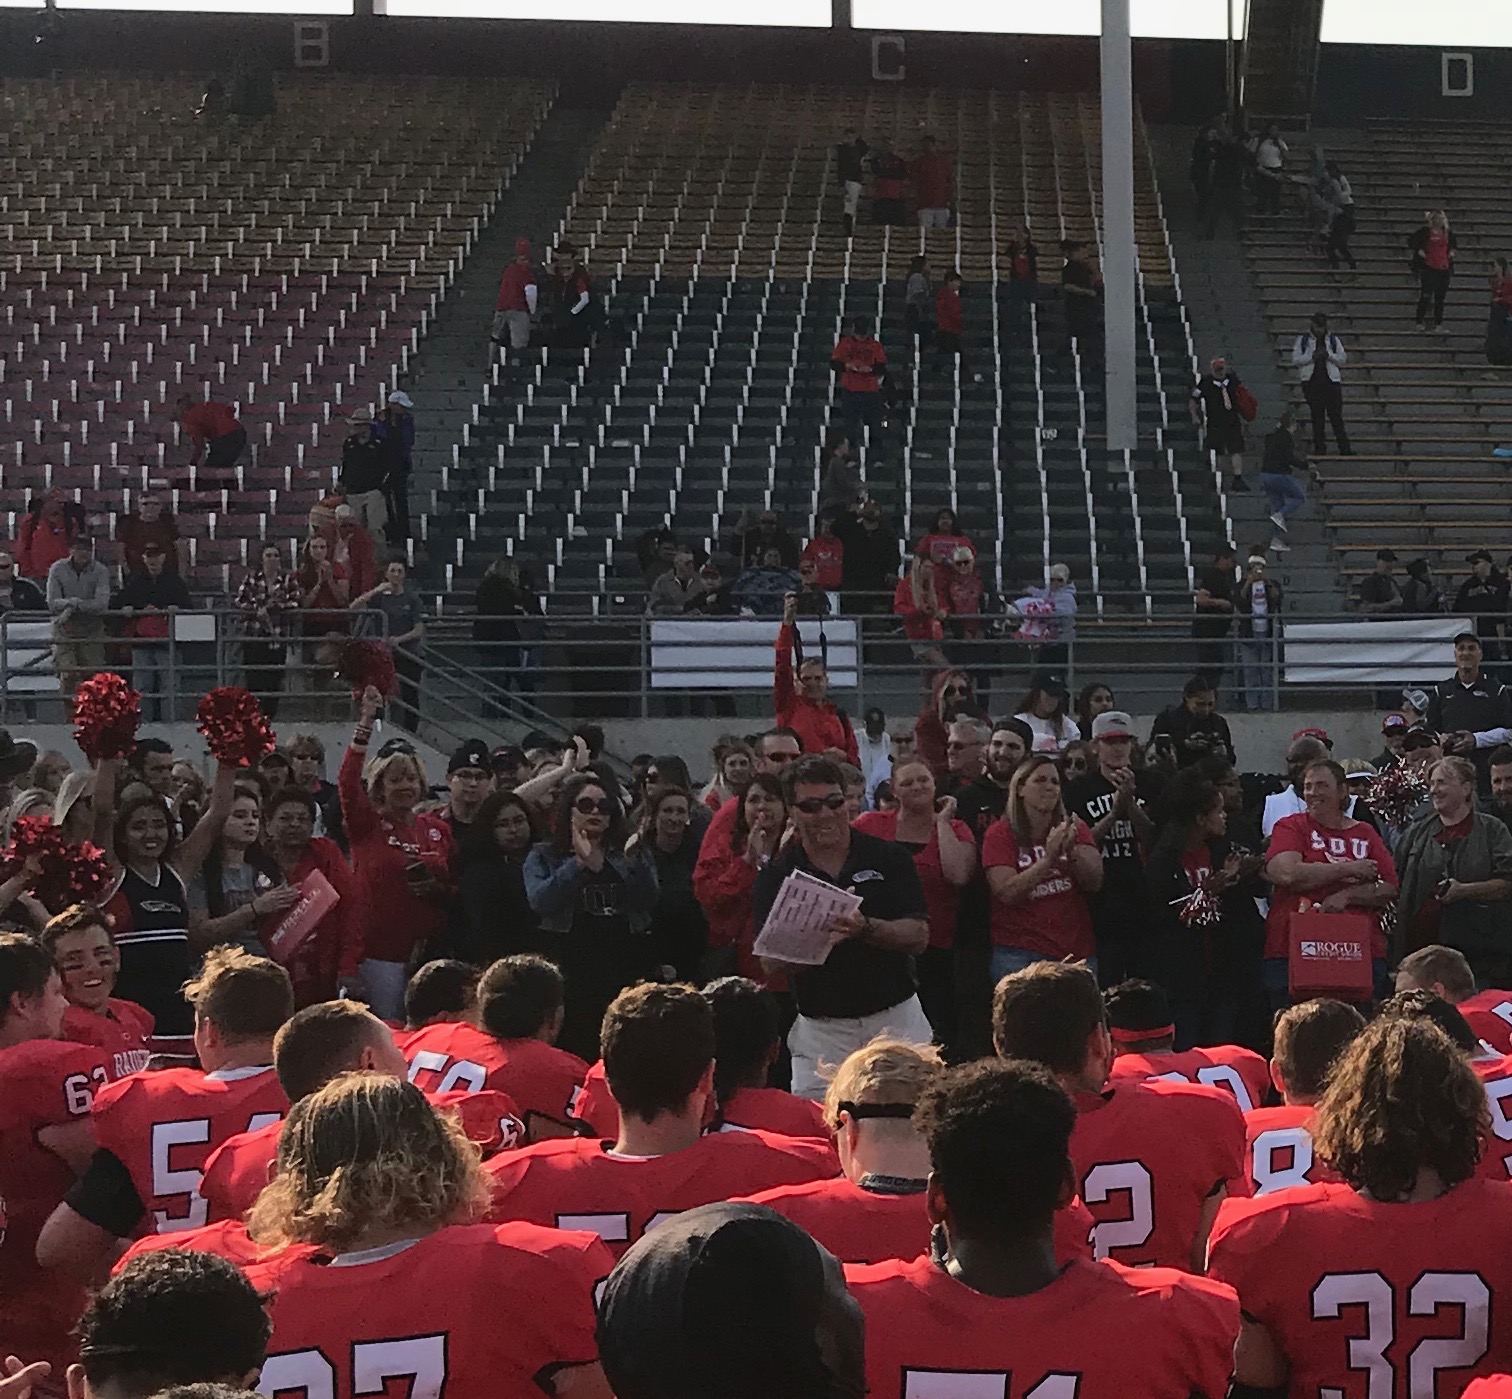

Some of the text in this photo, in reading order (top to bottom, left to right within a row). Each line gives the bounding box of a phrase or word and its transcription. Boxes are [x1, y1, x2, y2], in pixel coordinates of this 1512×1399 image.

[293, 20, 330, 67] B
[871, 35, 906, 80] C
[1441, 52, 1474, 97] D
[1317, 941, 1361, 952] ROGUE
